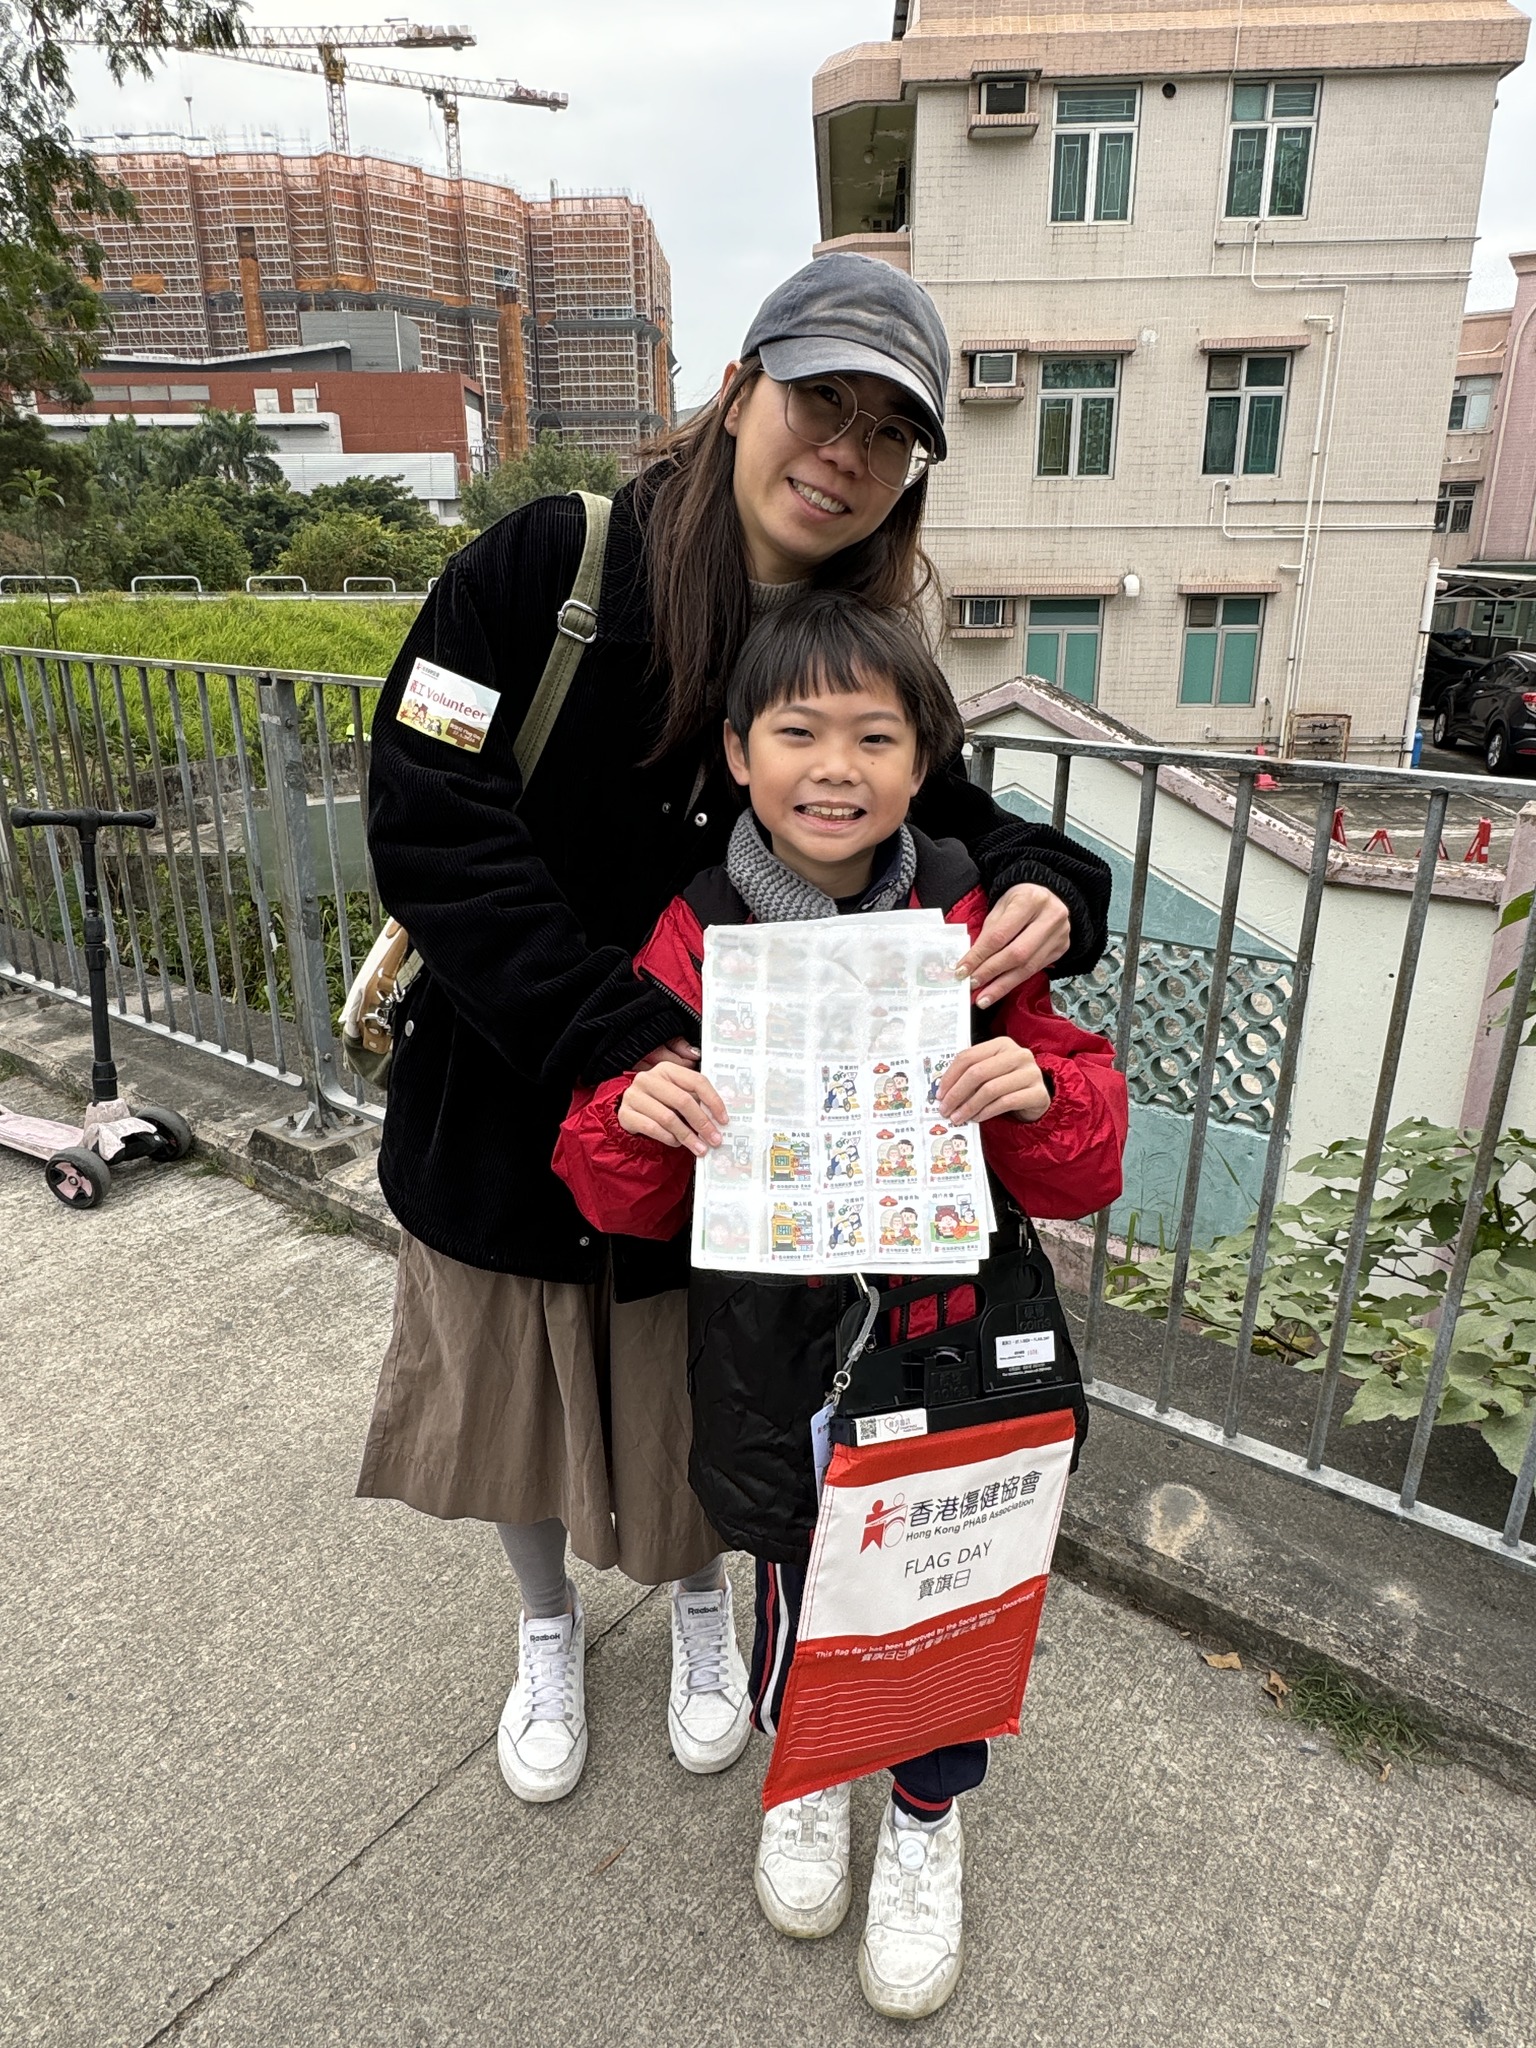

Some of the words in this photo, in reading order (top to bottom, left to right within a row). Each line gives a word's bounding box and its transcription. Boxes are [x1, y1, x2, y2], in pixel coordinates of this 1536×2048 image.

[427, 686, 487, 721] Volunteer
[1019, 1317, 1052, 1331] coins
[909, 1470, 1042, 1527] 香港傷健協會
[906, 1529, 932, 1541] Hong
[934, 1524, 960, 1535] Kong
[963, 1516, 988, 1530] PHAB
[989, 1498, 1034, 1520] Association
[904, 1552, 951, 1578] FLAG
[957, 1539, 993, 1564] DAY
[917, 1568, 971, 1601] 賣旗日
[687, 1605, 719, 1616] Reebok
[529, 1633, 561, 1643] Reebok
[816, 1650, 832, 1659] This
[834, 1648, 850, 1656] flag
[884, 1642, 904, 1651] been
[946, 1622, 957, 1631] the
[958, 1615, 978, 1627] Social
